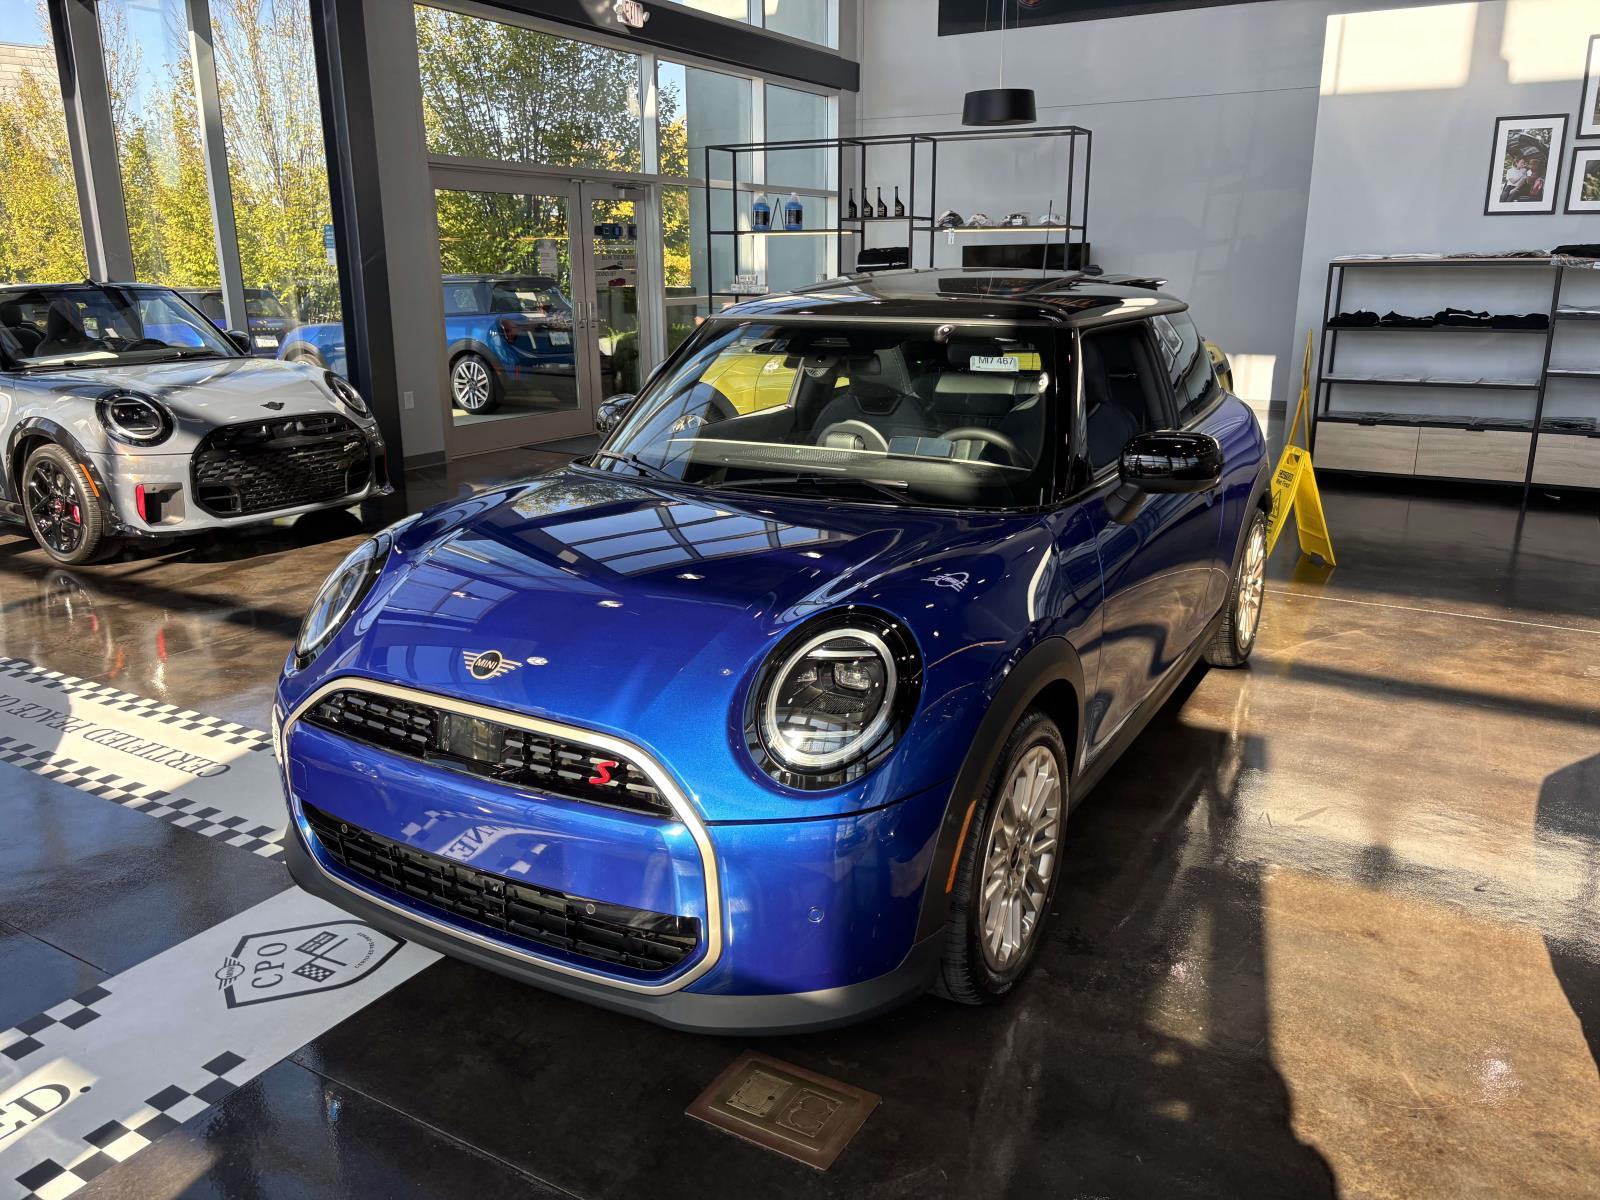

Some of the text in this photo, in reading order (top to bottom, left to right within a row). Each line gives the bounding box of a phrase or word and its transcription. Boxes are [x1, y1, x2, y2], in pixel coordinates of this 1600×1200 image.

[475, 659, 498, 670] MINI
[6, 702, 97, 733] PEACE
[83, 727, 231, 777] CERTIFIED
[589, 760, 618, 785] S
[251, 942, 288, 989] CPO
